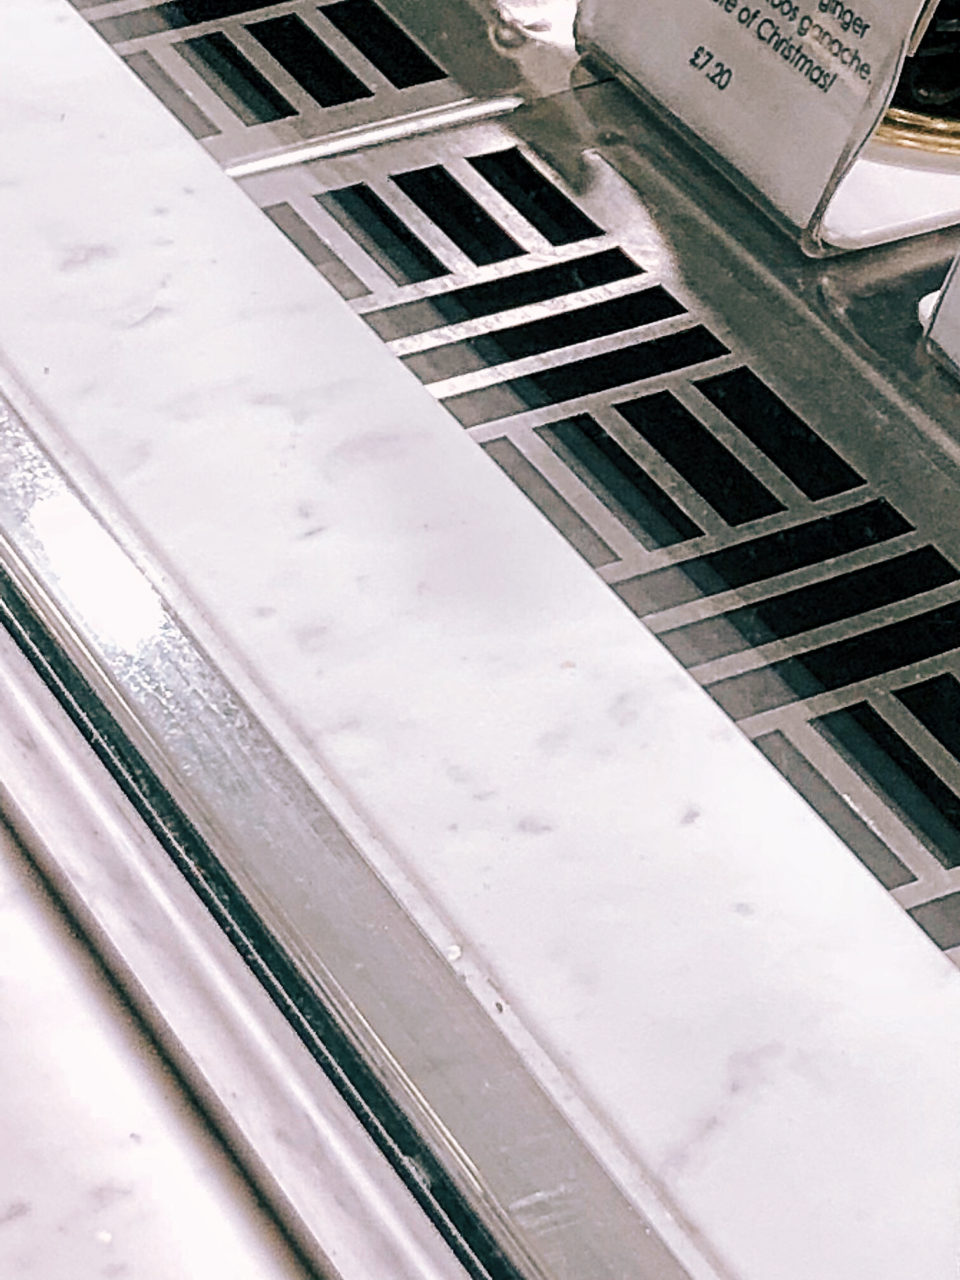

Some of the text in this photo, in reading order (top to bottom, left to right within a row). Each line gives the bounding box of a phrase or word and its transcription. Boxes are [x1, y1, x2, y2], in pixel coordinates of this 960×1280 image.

[689, 46, 733, 91] £7.20
[737, 6, 760, 29] of
[757, 18, 838, 93] Christmas!
[797, 15, 872, 84] ganache.
